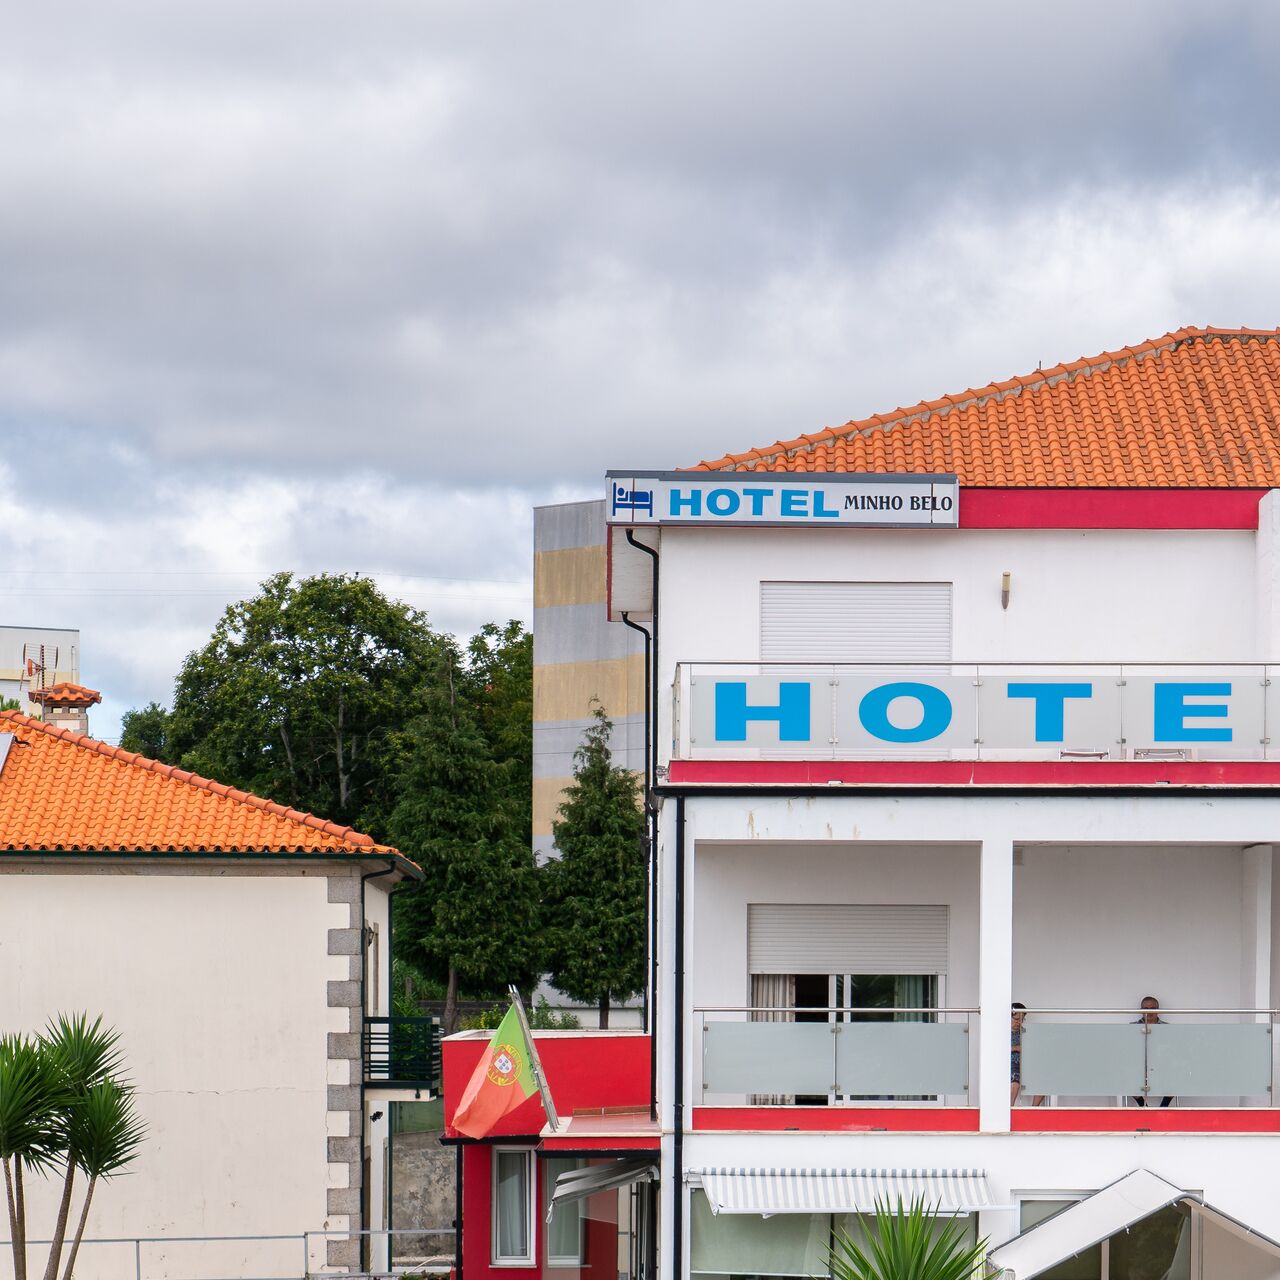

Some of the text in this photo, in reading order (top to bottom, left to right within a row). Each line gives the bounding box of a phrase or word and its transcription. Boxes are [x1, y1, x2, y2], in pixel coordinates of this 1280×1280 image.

[670, 488, 953, 518] HOTEL MINHO BELO
